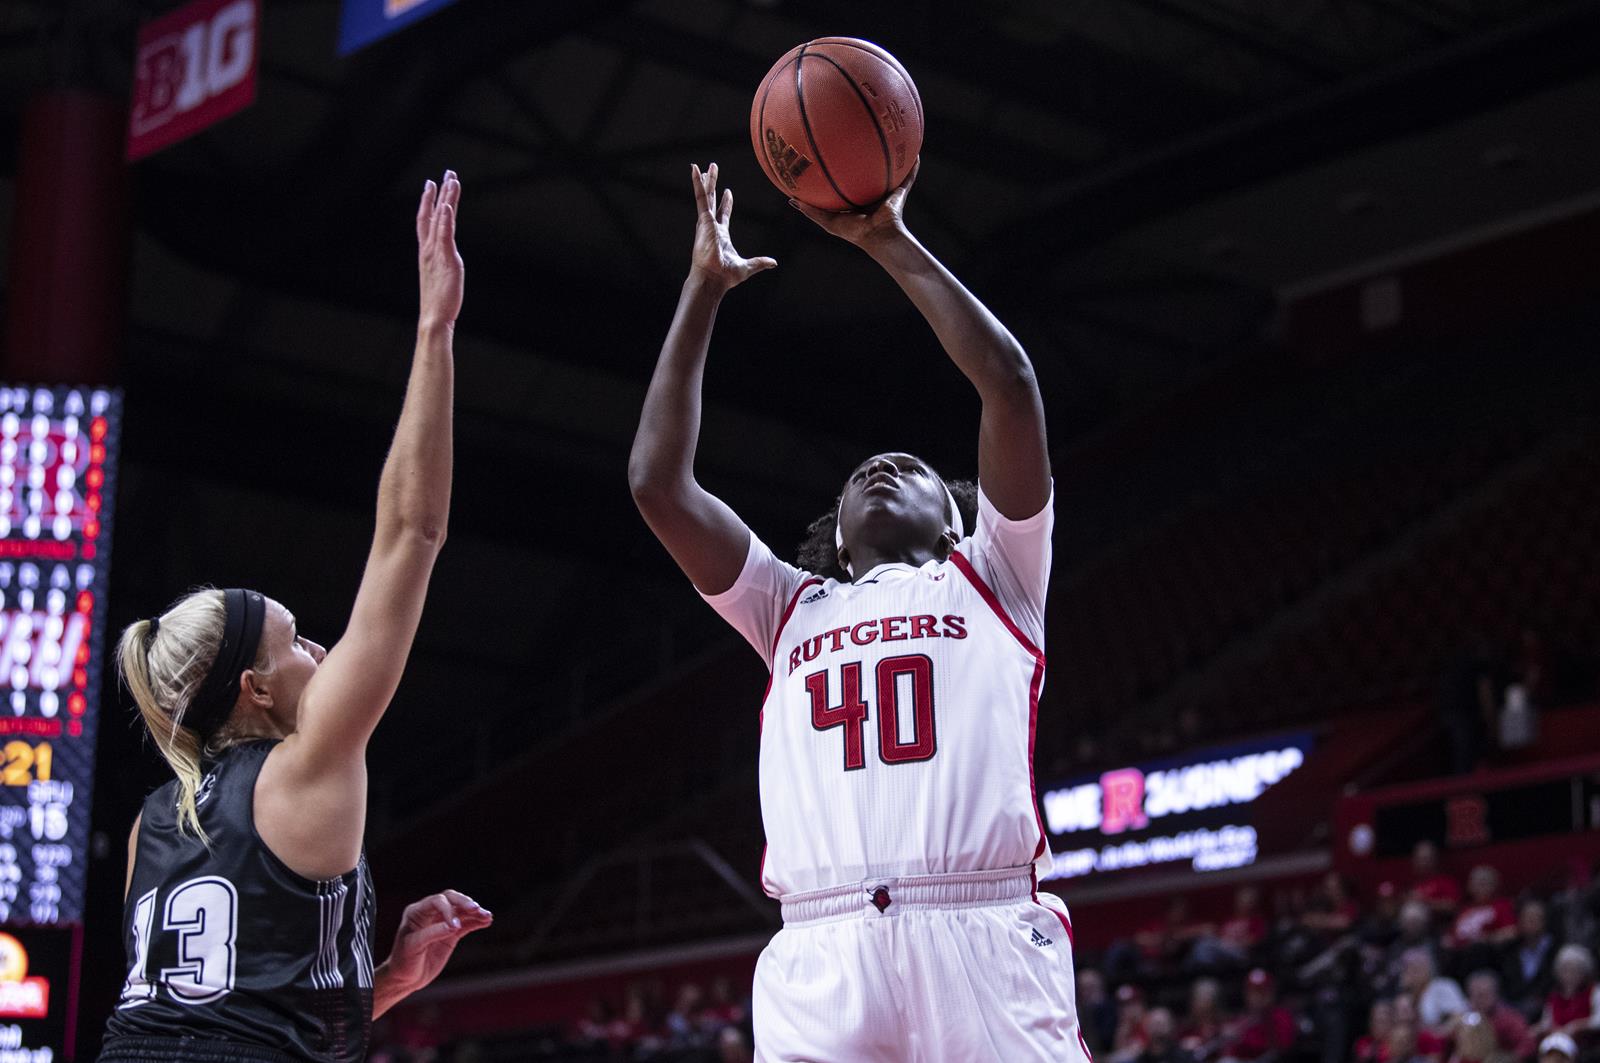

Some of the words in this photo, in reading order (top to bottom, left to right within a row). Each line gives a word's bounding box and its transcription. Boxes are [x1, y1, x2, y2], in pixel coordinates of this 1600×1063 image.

[788, 614, 968, 676] RUTGERS
[804, 653, 938, 772] 40
[118, 875, 239, 1010] 13
